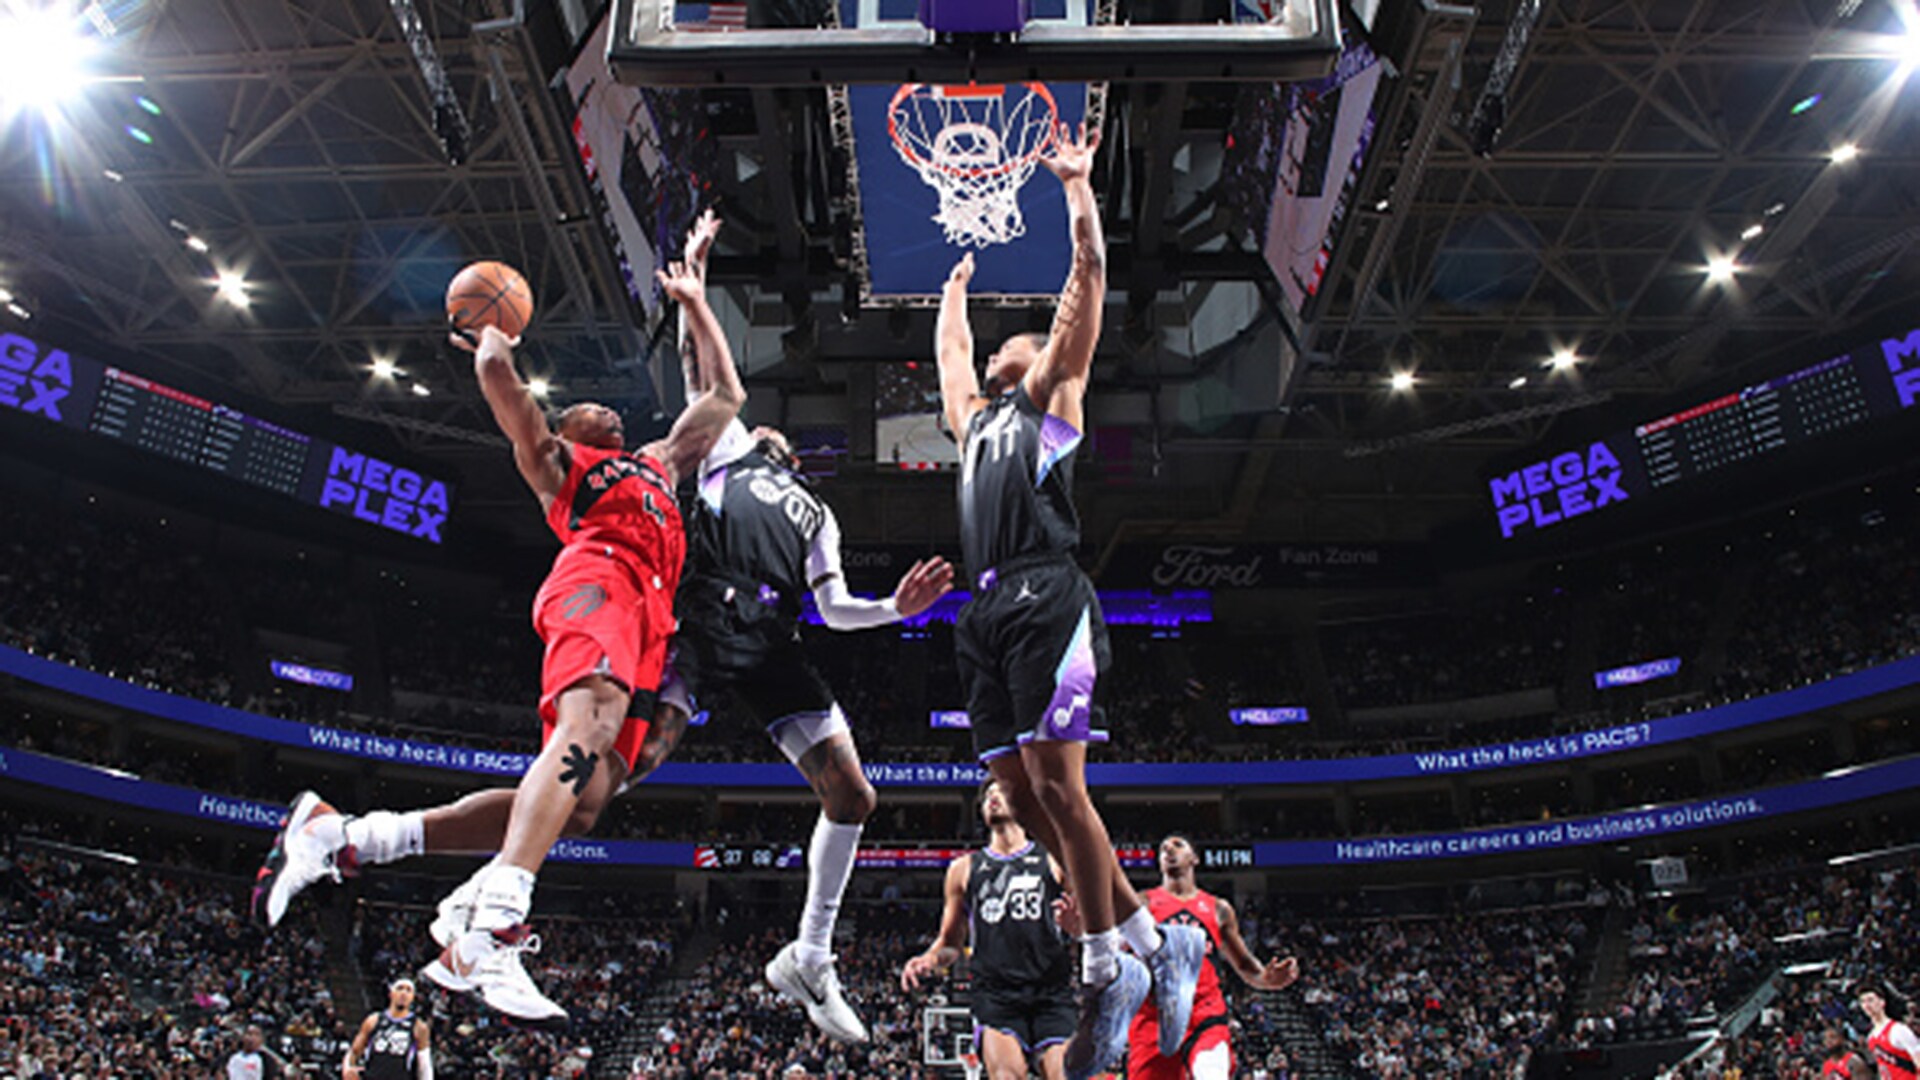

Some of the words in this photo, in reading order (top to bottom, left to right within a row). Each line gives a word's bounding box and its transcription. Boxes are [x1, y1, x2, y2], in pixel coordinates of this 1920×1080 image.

[328, 446, 448, 513] MEGA
[1489, 440, 1620, 508] MEGA
[320, 478, 447, 544] PLEX
[1498, 469, 1629, 538] PLEX
[1152, 544, 1263, 586] Ford
[1279, 548, 1320, 564] Fan
[1324, 547, 1379, 564] Zone
[309, 727, 360, 752] What
[365, 737, 396, 757] the
[400, 742, 447, 764] heck
[450, 750, 467, 766] is
[1415, 754, 1468, 771] What
[1472, 748, 1504, 764] the
[1508, 739, 1557, 761] heck
[1560, 737, 1578, 755] is
[865, 765, 913, 781] What
[917, 765, 948, 781] the
[952, 765, 990, 781] hec
[200, 794, 279, 826] Healthc
[1337, 839, 1442, 859] Healthcare
[1447, 832, 1520, 852] careers
[1525, 824, 1563, 846] and
[1566, 813, 1656, 839] business
[1661, 797, 1764, 827] solutions.
[549, 840, 609, 858] tions.
[1011, 891, 1041, 920] 33
